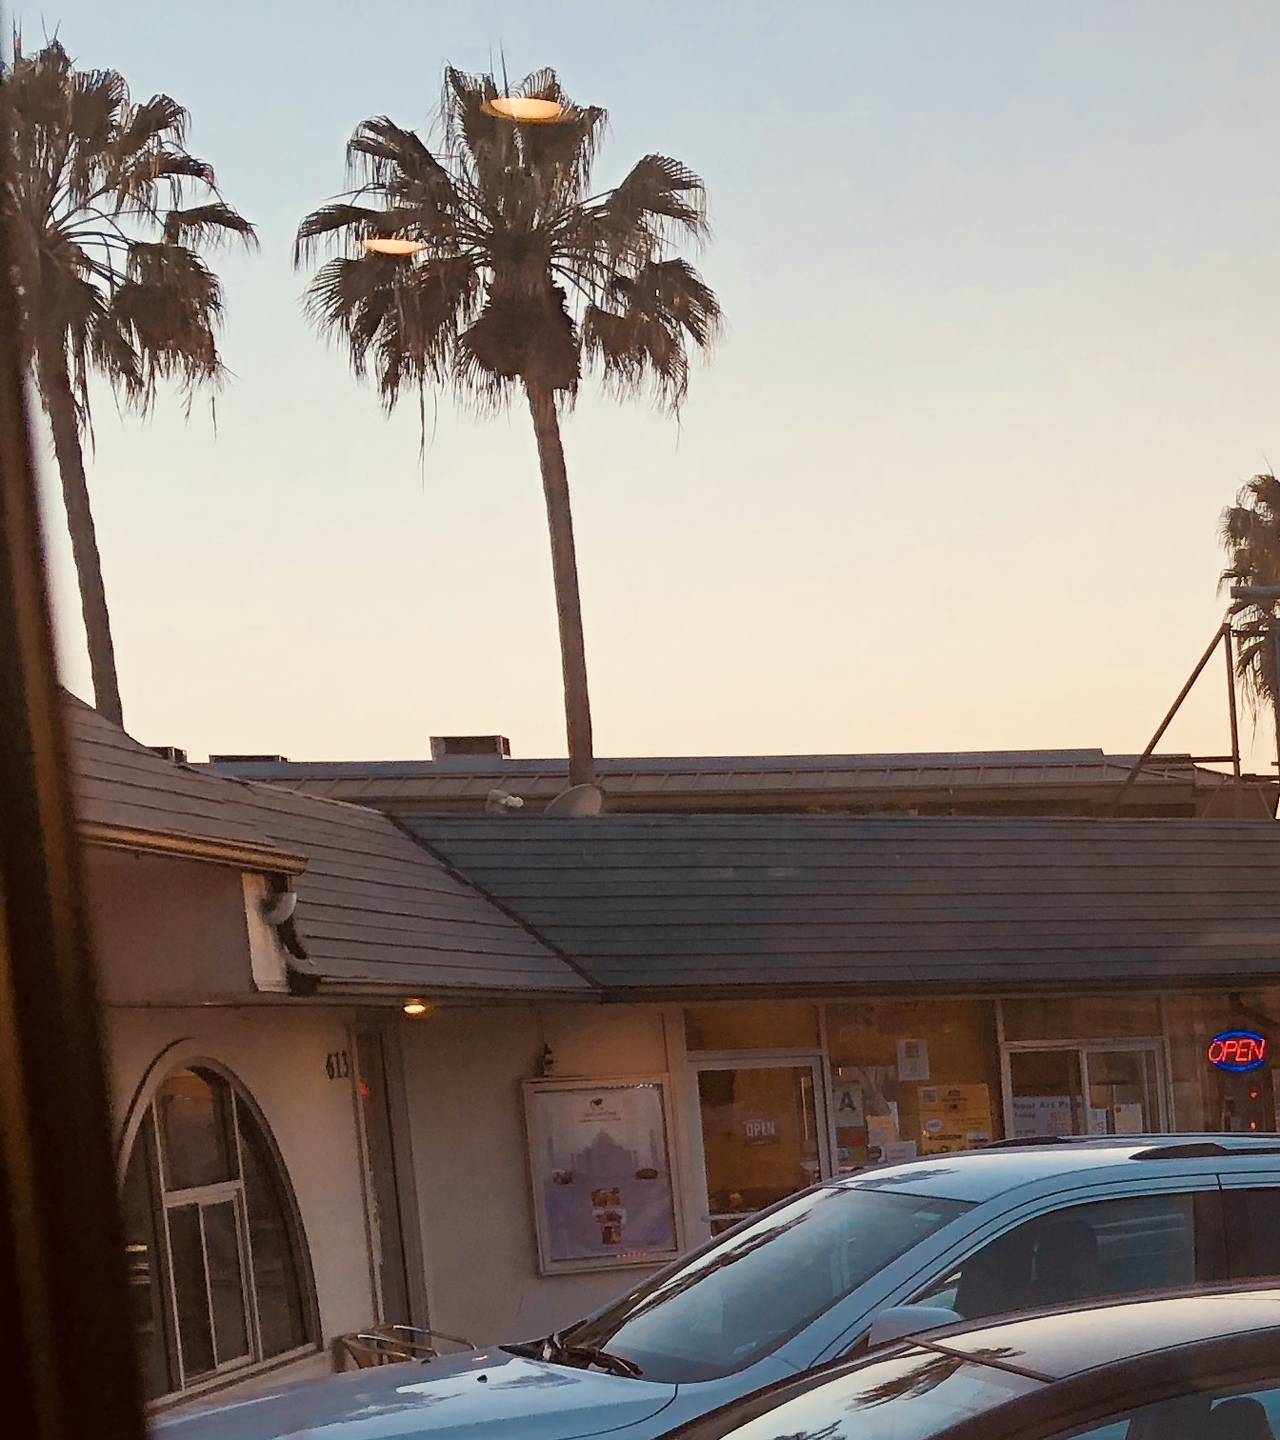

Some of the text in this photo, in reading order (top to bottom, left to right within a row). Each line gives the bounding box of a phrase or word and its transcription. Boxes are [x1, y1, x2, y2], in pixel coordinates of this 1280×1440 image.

[1208, 1039, 1265, 1063] OPEN
[838, 1091, 856, 1111] A
[746, 1120, 775, 1136] OPEN
